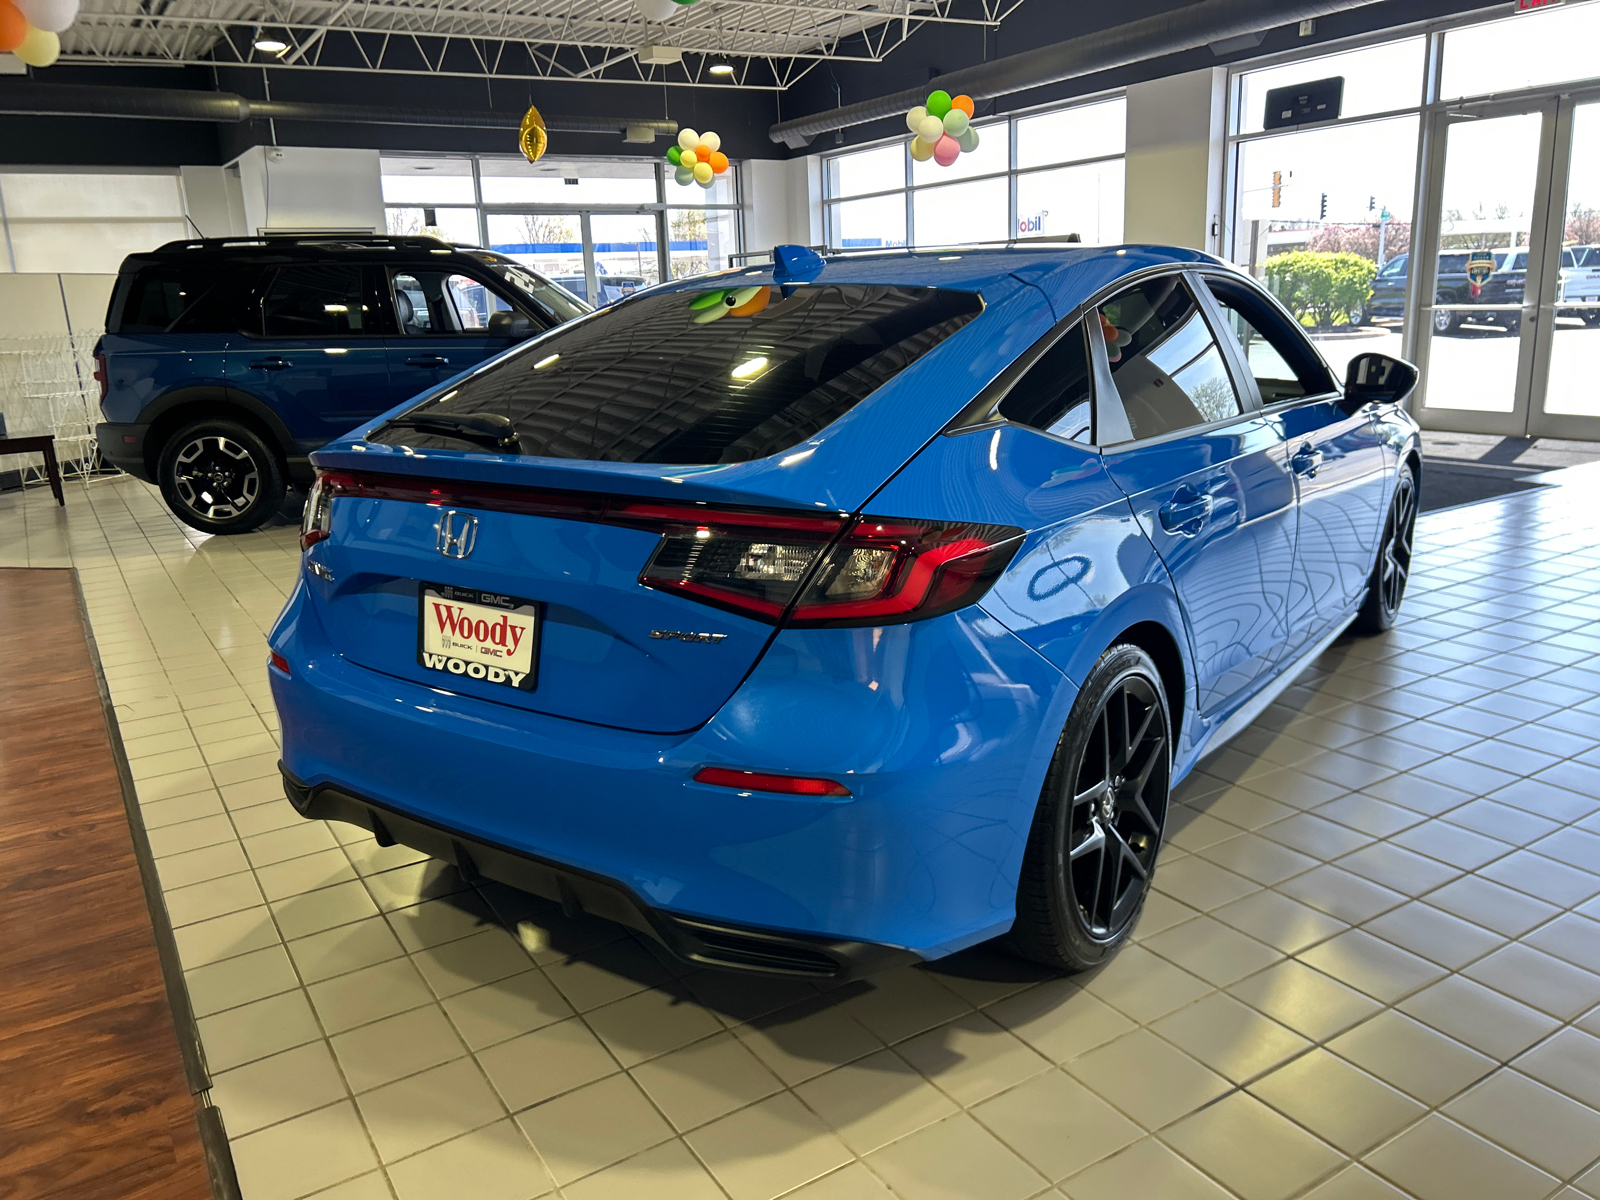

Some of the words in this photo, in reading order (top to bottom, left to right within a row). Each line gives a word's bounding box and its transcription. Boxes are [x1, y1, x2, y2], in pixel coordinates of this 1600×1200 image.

[1018, 216, 1041, 233] obil
[481, 593, 511, 606] GMC
[432, 602, 526, 657] Woody
[648, 630, 728, 644] SPORT
[452, 642, 473, 650] BUICK
[480, 646, 503, 658] GMC
[422, 652, 527, 688] WOODY
